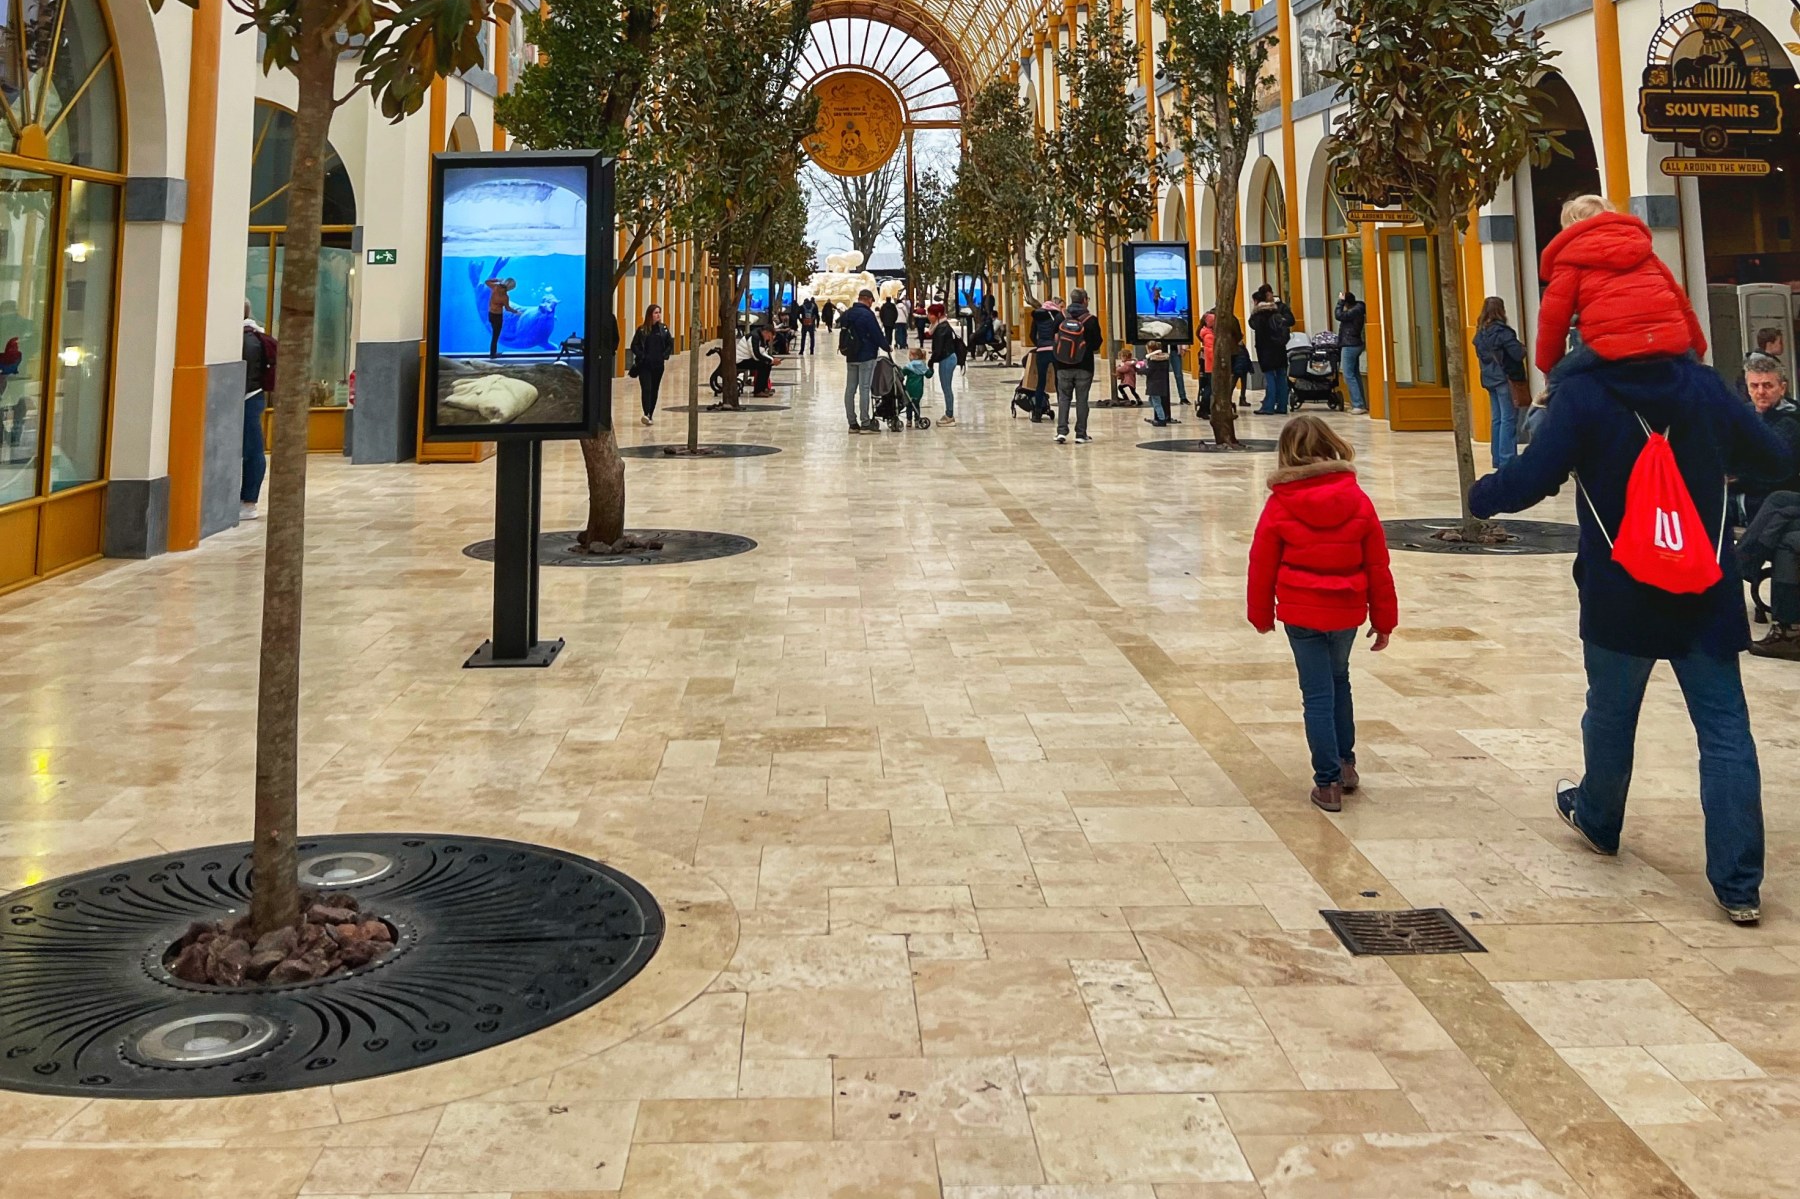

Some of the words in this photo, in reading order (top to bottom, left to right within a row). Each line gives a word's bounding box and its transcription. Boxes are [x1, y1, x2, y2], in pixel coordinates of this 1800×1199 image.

[1665, 103, 1759, 118] SOUVENIRS
[1665, 162, 1680, 172] ALL
[1683, 162, 1717, 172] AROUND
[1719, 163, 1735, 172] THE
[1738, 163, 1767, 173] WORLD
[1654, 507, 1683, 551] LU
